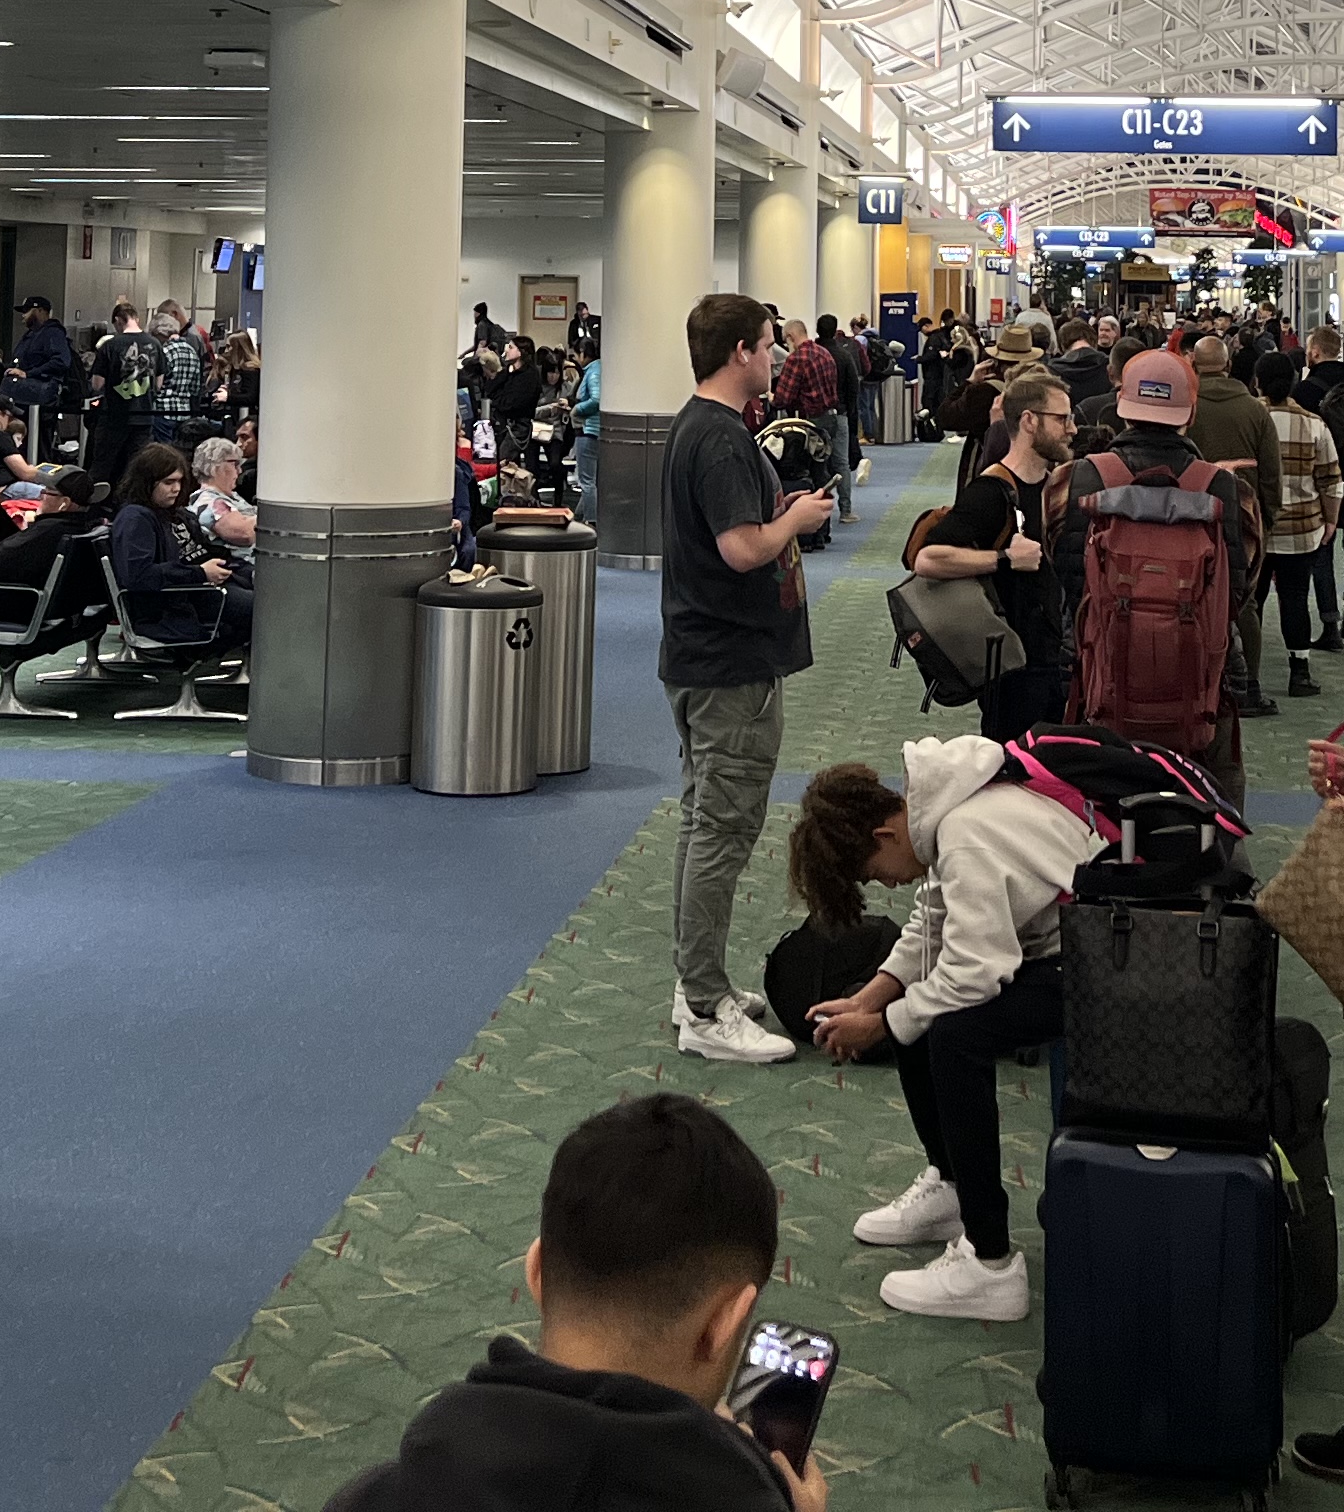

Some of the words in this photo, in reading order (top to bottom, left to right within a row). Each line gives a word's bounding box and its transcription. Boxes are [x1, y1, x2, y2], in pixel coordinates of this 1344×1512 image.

[1121, 109, 1204, 136] C11-C23
[865, 188, 896, 214] C11
[1078, 231, 1110, 242] C13-C23
